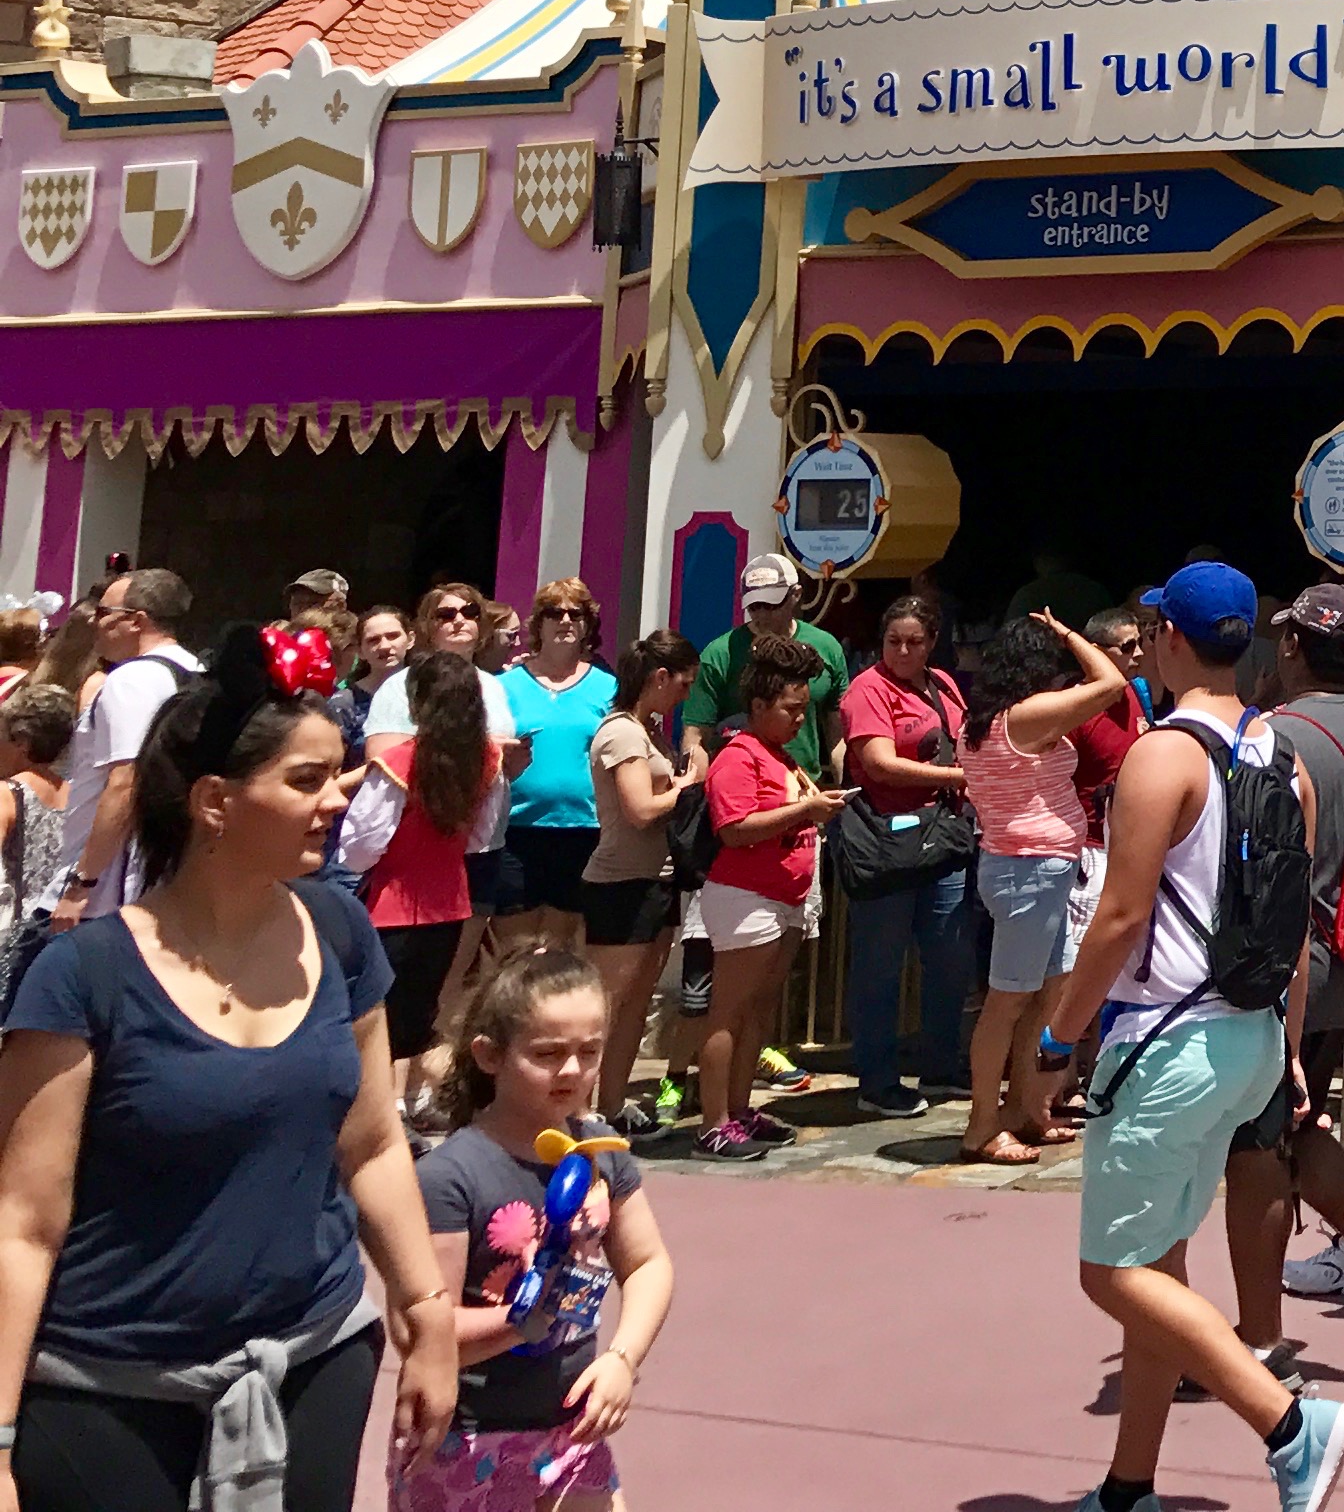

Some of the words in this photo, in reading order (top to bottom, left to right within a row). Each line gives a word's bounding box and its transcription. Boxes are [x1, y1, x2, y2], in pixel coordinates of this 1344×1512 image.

[873, 71, 899, 118] a
[916, 32, 1084, 113] small
[1027, 181, 1170, 220] stand-by
[1043, 222, 1151, 248] entrance
[837, 489, 868, 518] 25
